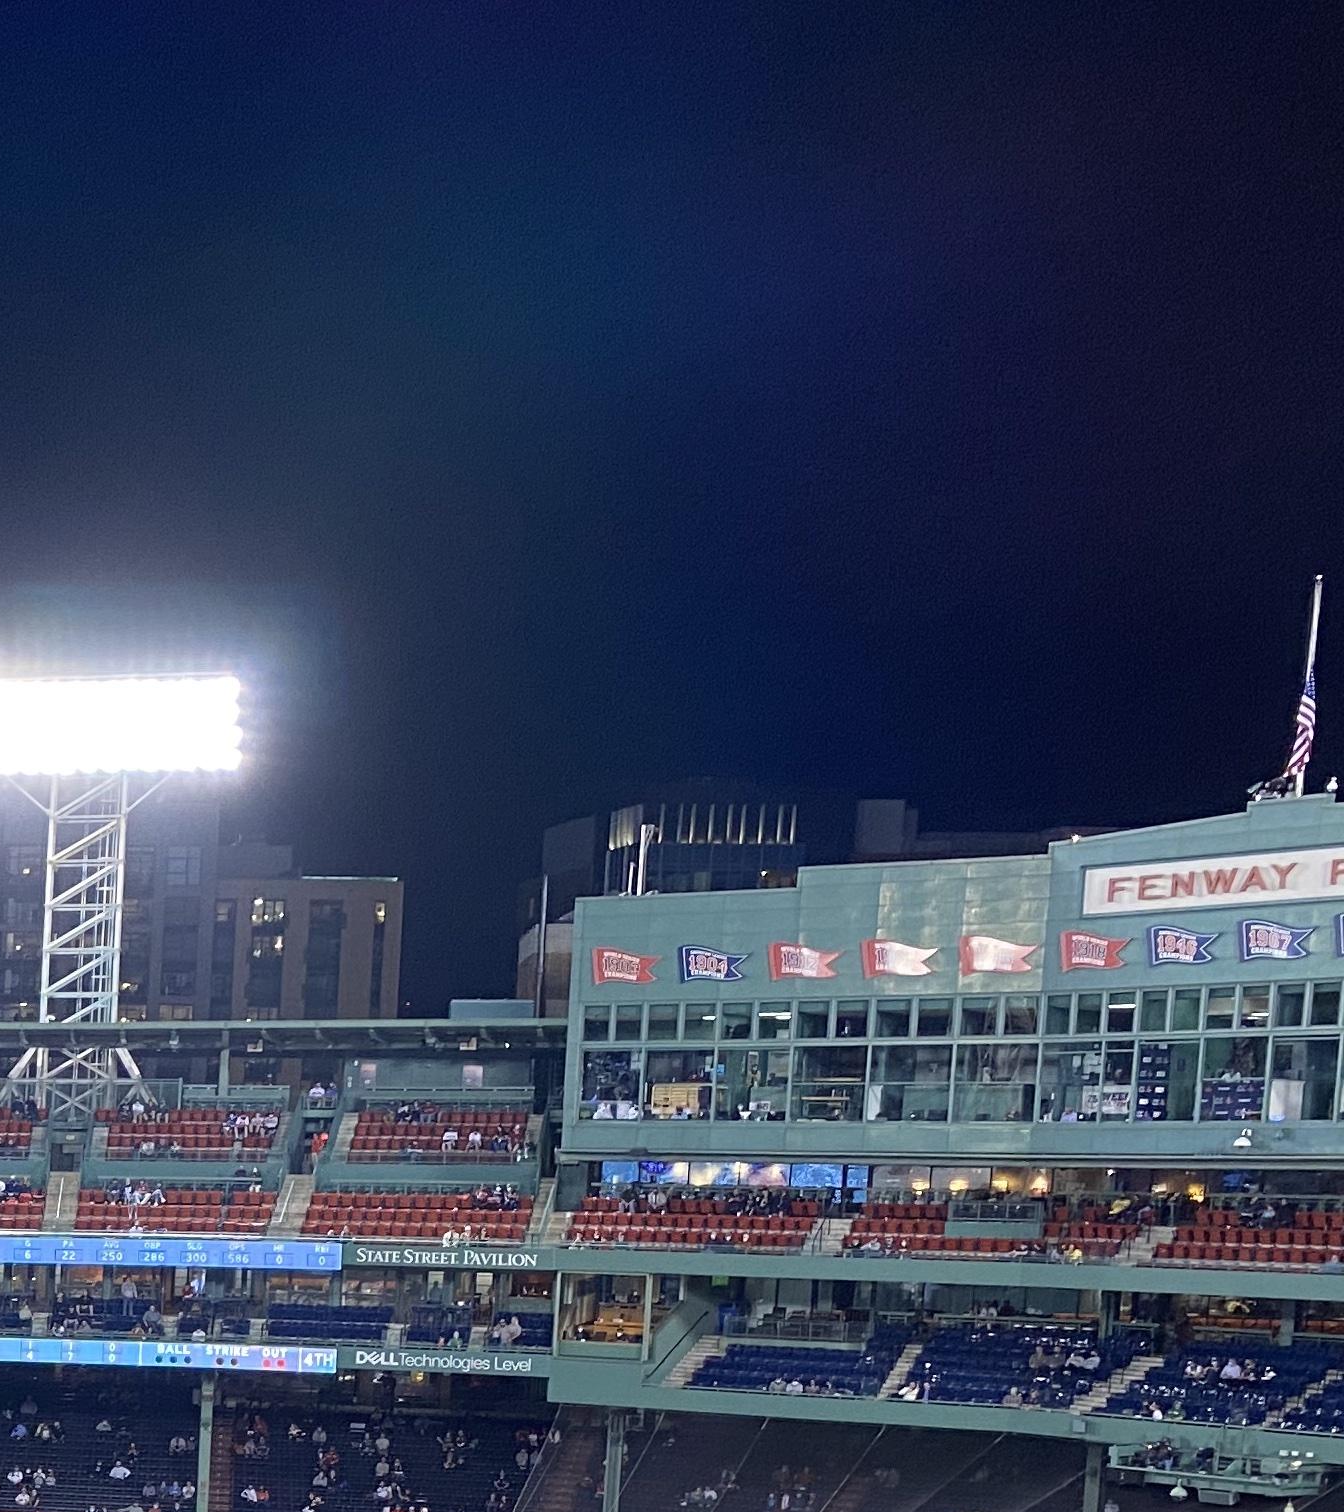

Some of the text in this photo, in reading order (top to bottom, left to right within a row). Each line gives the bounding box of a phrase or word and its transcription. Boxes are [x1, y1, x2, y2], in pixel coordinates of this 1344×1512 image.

[1107, 862, 1299, 903] FENWAY
[1157, 934, 1198, 954] 1946
[1248, 929, 1293, 951] 1967
[24, 1250, 32, 1260] 6
[61, 1250, 76, 1261] 22
[275, 1254, 283, 1265] 0
[318, 1255, 326, 1266] 0
[356, 1247, 538, 1267] STATE STREET PAVILION
[109, 1343, 116, 1351] 0
[156, 1345, 288, 1358] BALL STRIKE OUT
[26, 1351, 33, 1360] 4
[109, 1354, 116, 1362] 0
[303, 1353, 334, 1367] 4TH
[355, 1350, 532, 1372] DELL Technologies Level
